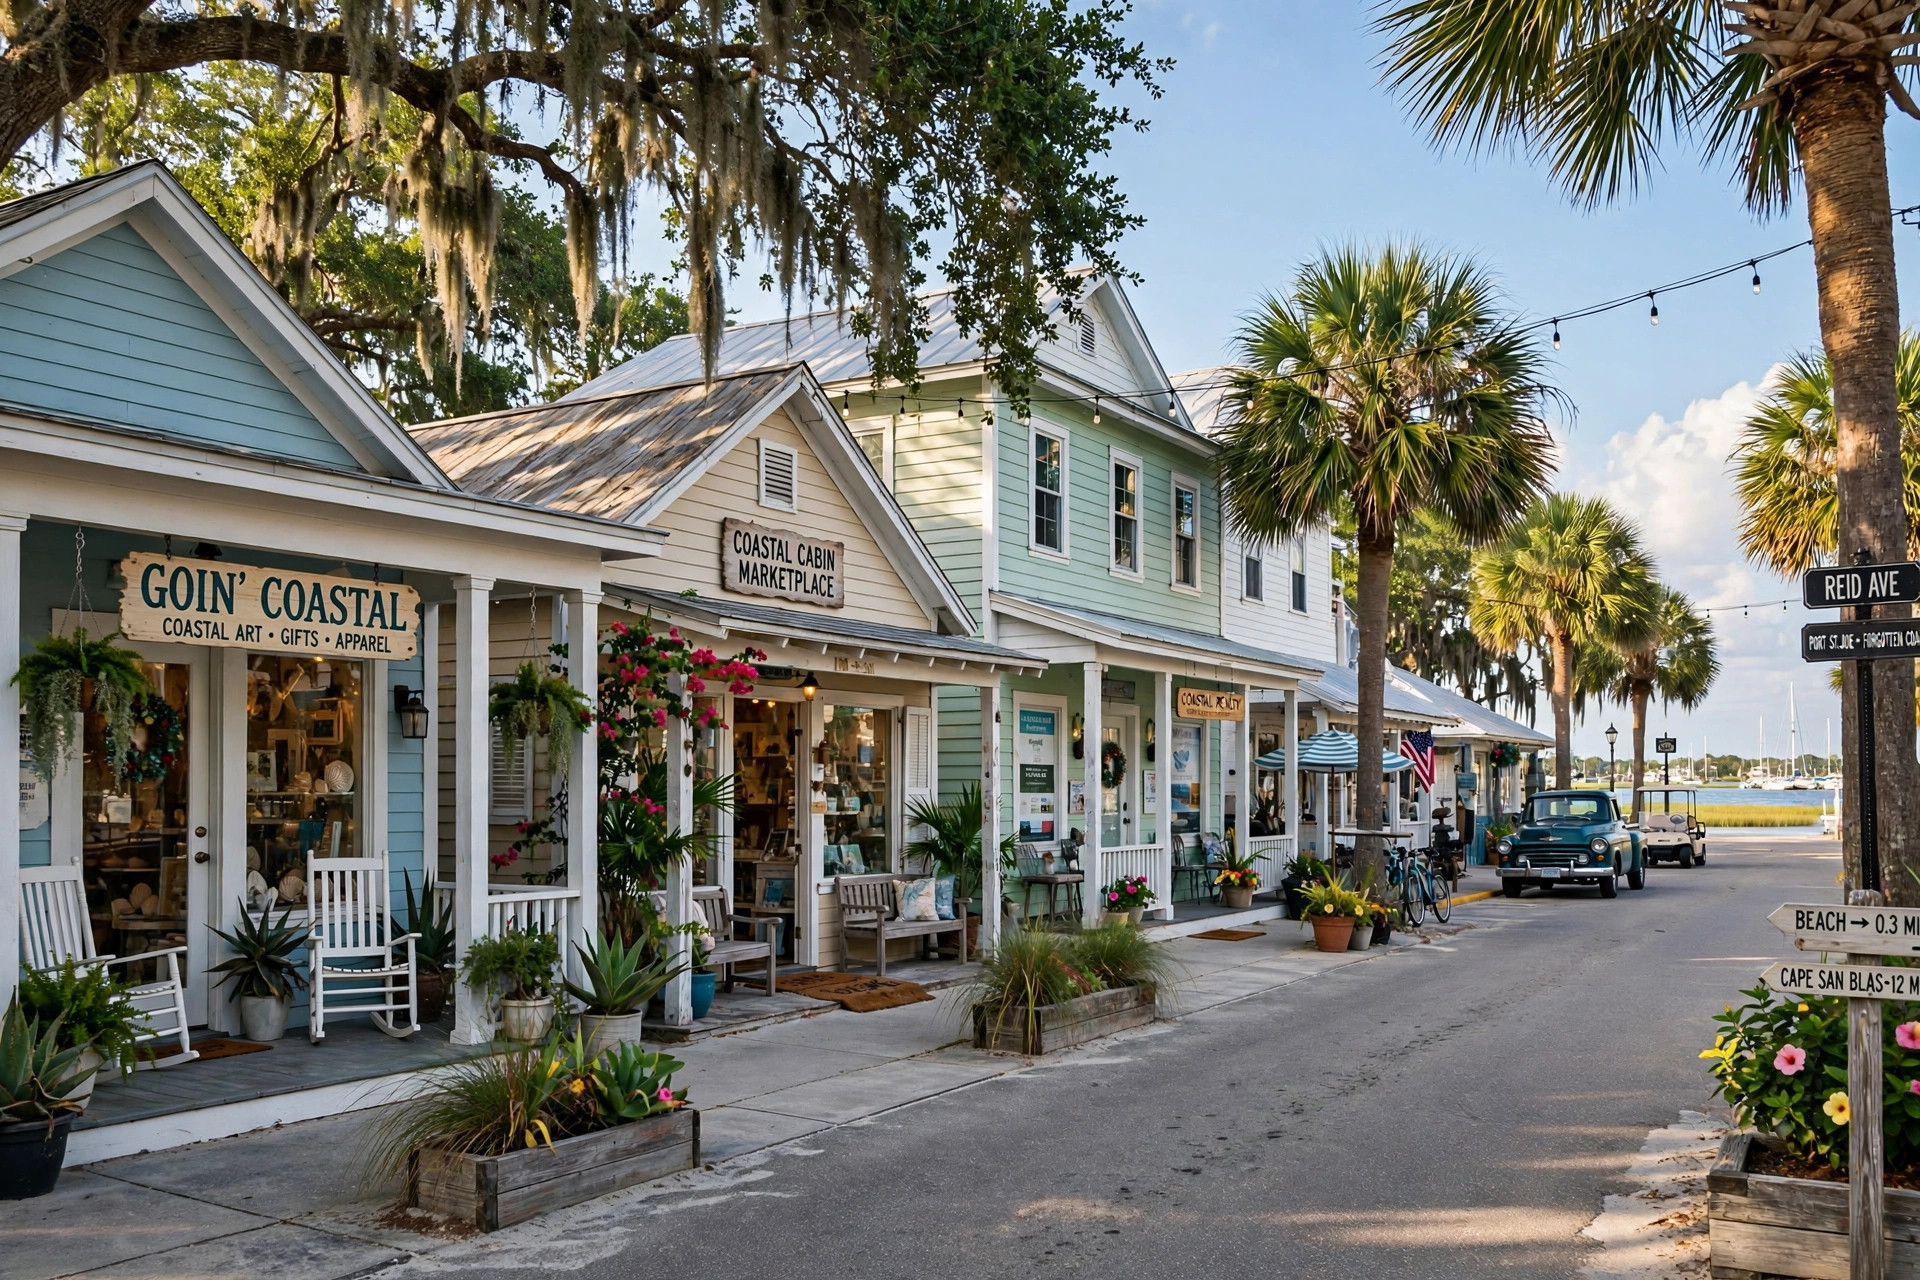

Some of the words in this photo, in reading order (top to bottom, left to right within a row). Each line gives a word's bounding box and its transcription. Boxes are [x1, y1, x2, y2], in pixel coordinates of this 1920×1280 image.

[734, 530, 792, 563] COASTAL
[797, 543, 835, 571] CABIN
[739, 559, 834, 598] MARKETPLACE
[1825, 573, 1862, 601] REID
[1868, 571, 1900, 598] AVE
[141, 563, 246, 615] GOIN'
[261, 576, 407, 632] COASTAL
[162, 617, 229, 640] COASTAL
[235, 624, 262, 643] ART
[281, 628, 319, 648] GIFTS
[335, 632, 392, 653] APPAREL
[1809, 635, 1827, 650] PORT
[1795, 910, 1846, 932] BEACH
[1875, 914, 1898, 934] 0.3
[1904, 915, 1920, 936] MI
[1780, 967, 1814, 988] CAPE
[1818, 970, 1844, 990] SAN
